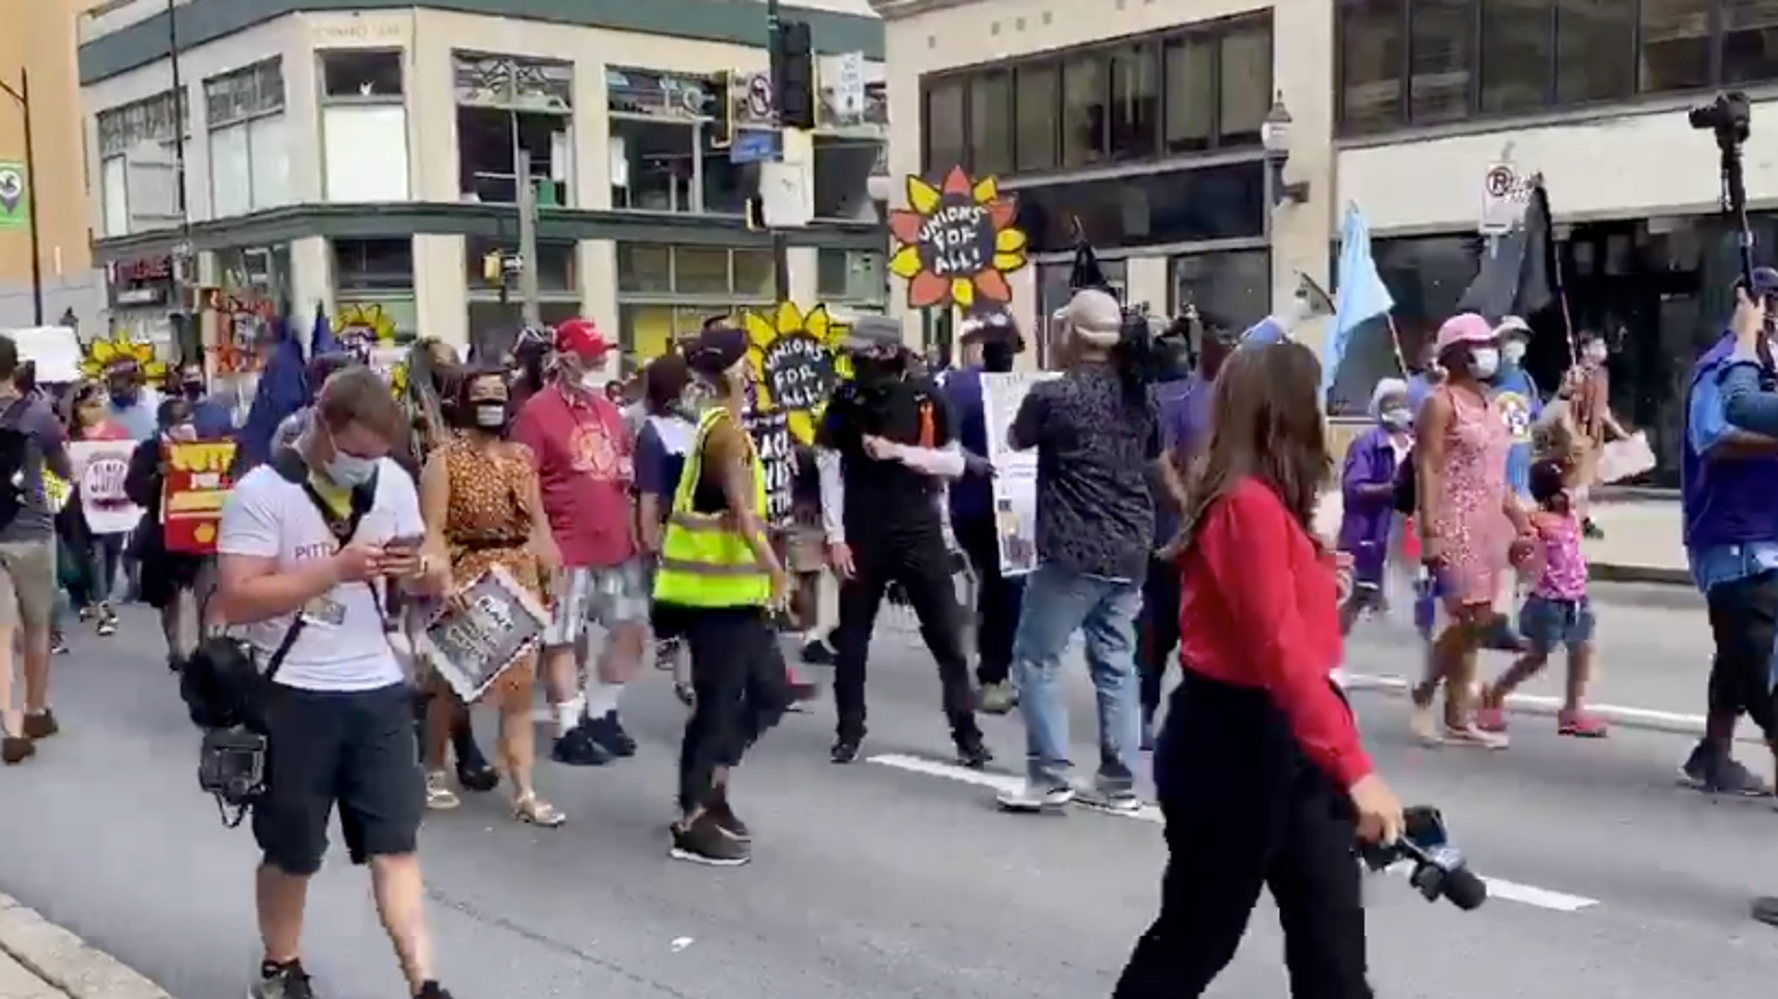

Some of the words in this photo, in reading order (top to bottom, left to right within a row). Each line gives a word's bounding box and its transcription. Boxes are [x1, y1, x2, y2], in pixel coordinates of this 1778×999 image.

[918, 205, 988, 241] UNIONS
[933, 226, 977, 252] FOR
[935, 248, 983, 275] ALL!
[765, 338, 823, 370] UNIONS
[773, 365, 816, 388] FOR
